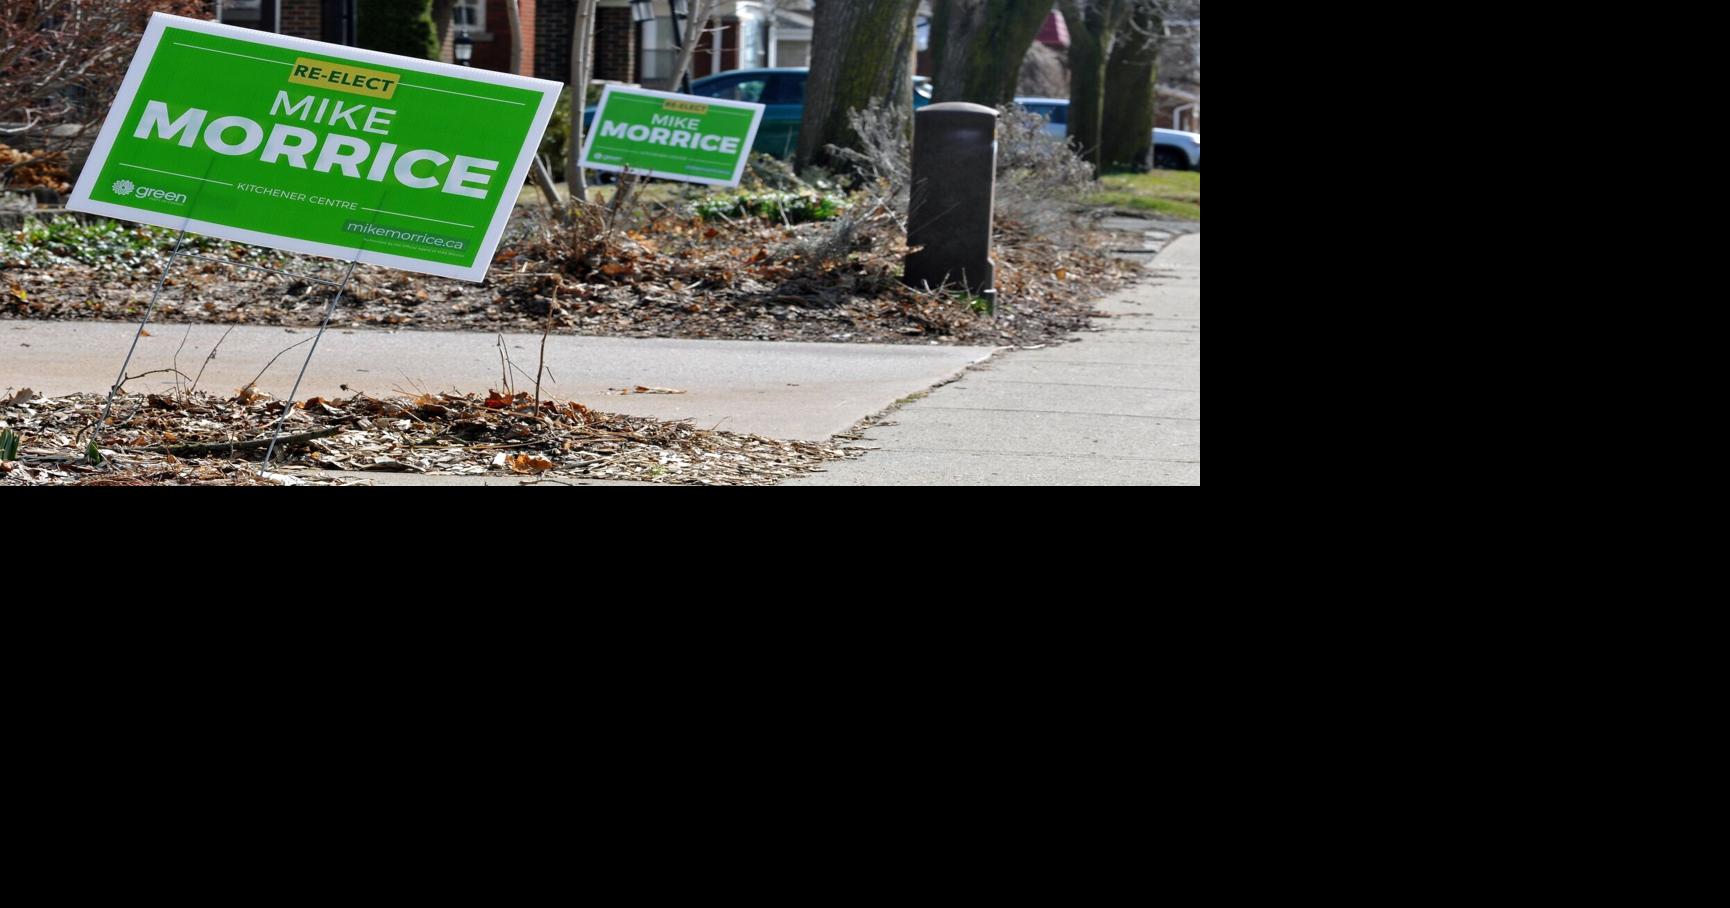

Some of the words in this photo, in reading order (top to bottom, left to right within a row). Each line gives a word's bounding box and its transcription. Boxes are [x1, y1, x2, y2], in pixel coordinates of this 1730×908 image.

[293, 63, 394, 93] RE-ELECT
[269, 90, 396, 135] MIKE
[651, 114, 700, 130] MIKE
[133, 100, 499, 199] MORRICE
[601, 120, 739, 153] MORRICE
[135, 186, 187, 203] green
[237, 182, 306, 201] KITCHENER
[309, 195, 358, 210] CENTRE
[347, 223, 463, 249] mikemorrice.ca
